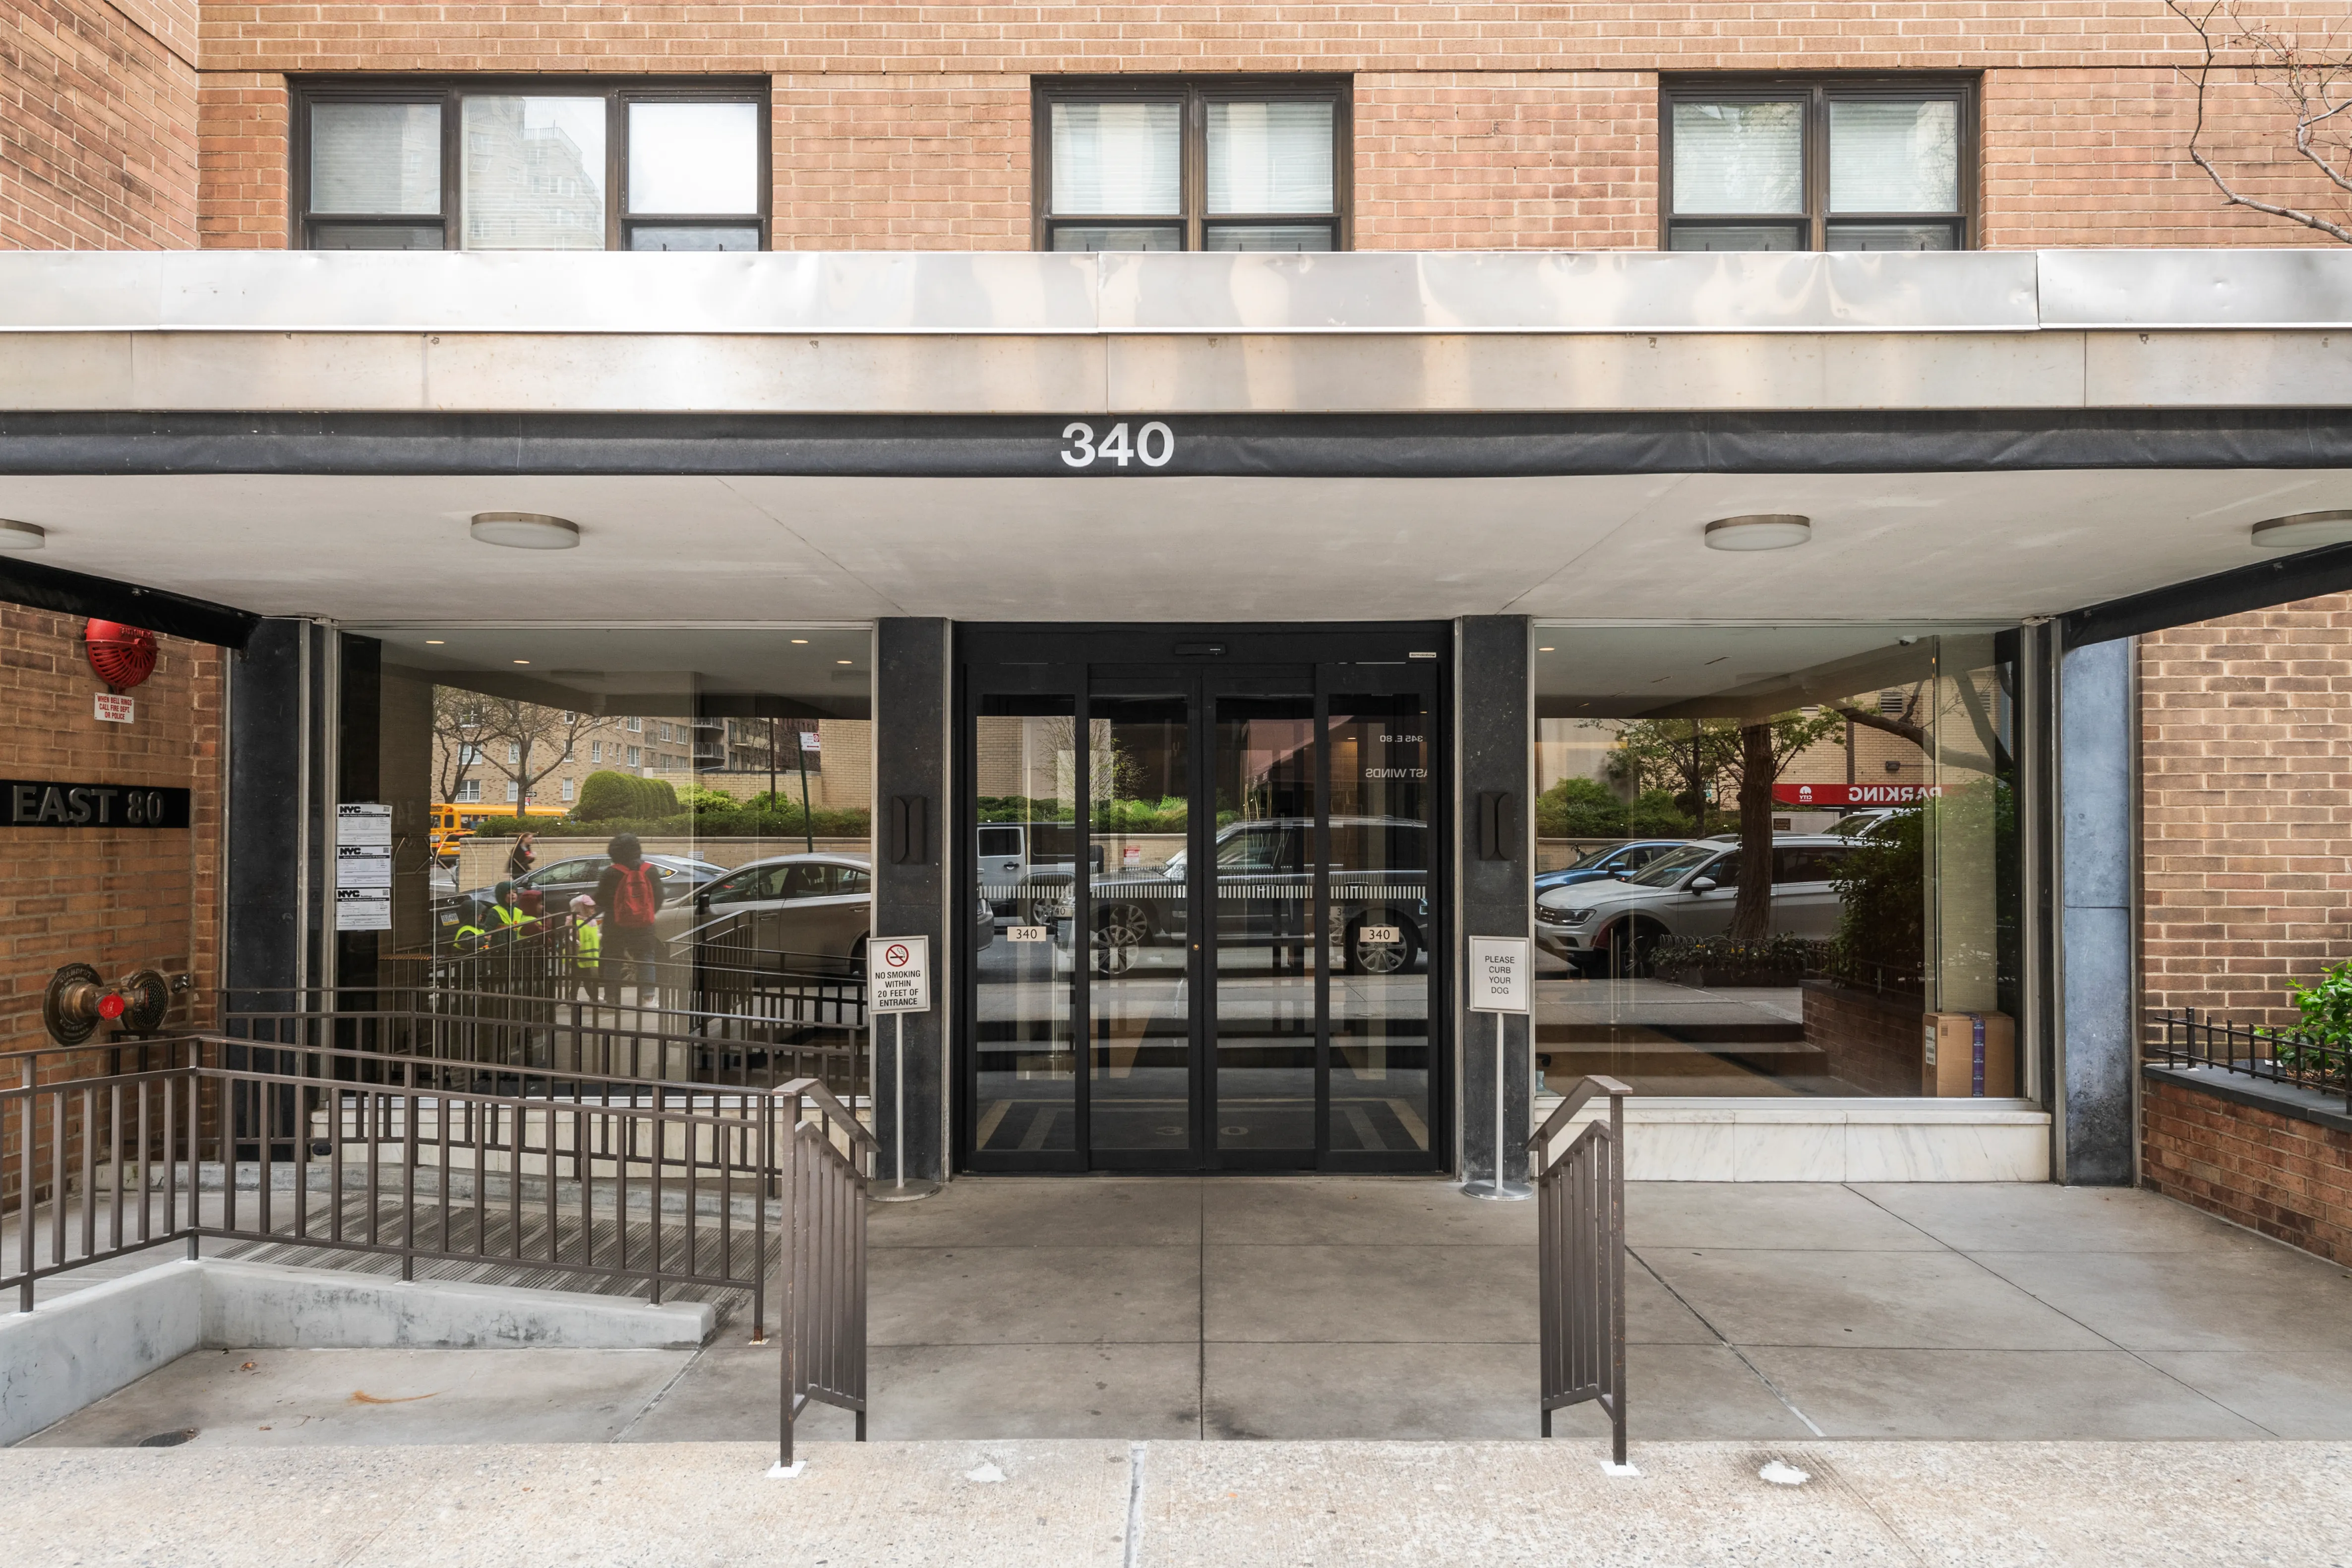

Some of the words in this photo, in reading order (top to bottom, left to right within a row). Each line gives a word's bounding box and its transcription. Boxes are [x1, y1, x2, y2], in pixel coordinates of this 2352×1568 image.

[1061, 421, 1174, 467] 340
[13, 785, 118, 823] EAST
[127, 791, 164, 825] 80
[1017, 929, 1037, 939] 340
[1369, 929, 1390, 940] 340
[887, 970, 920, 978] SMOKING
[880, 998, 917, 1007] ENTRANCE
